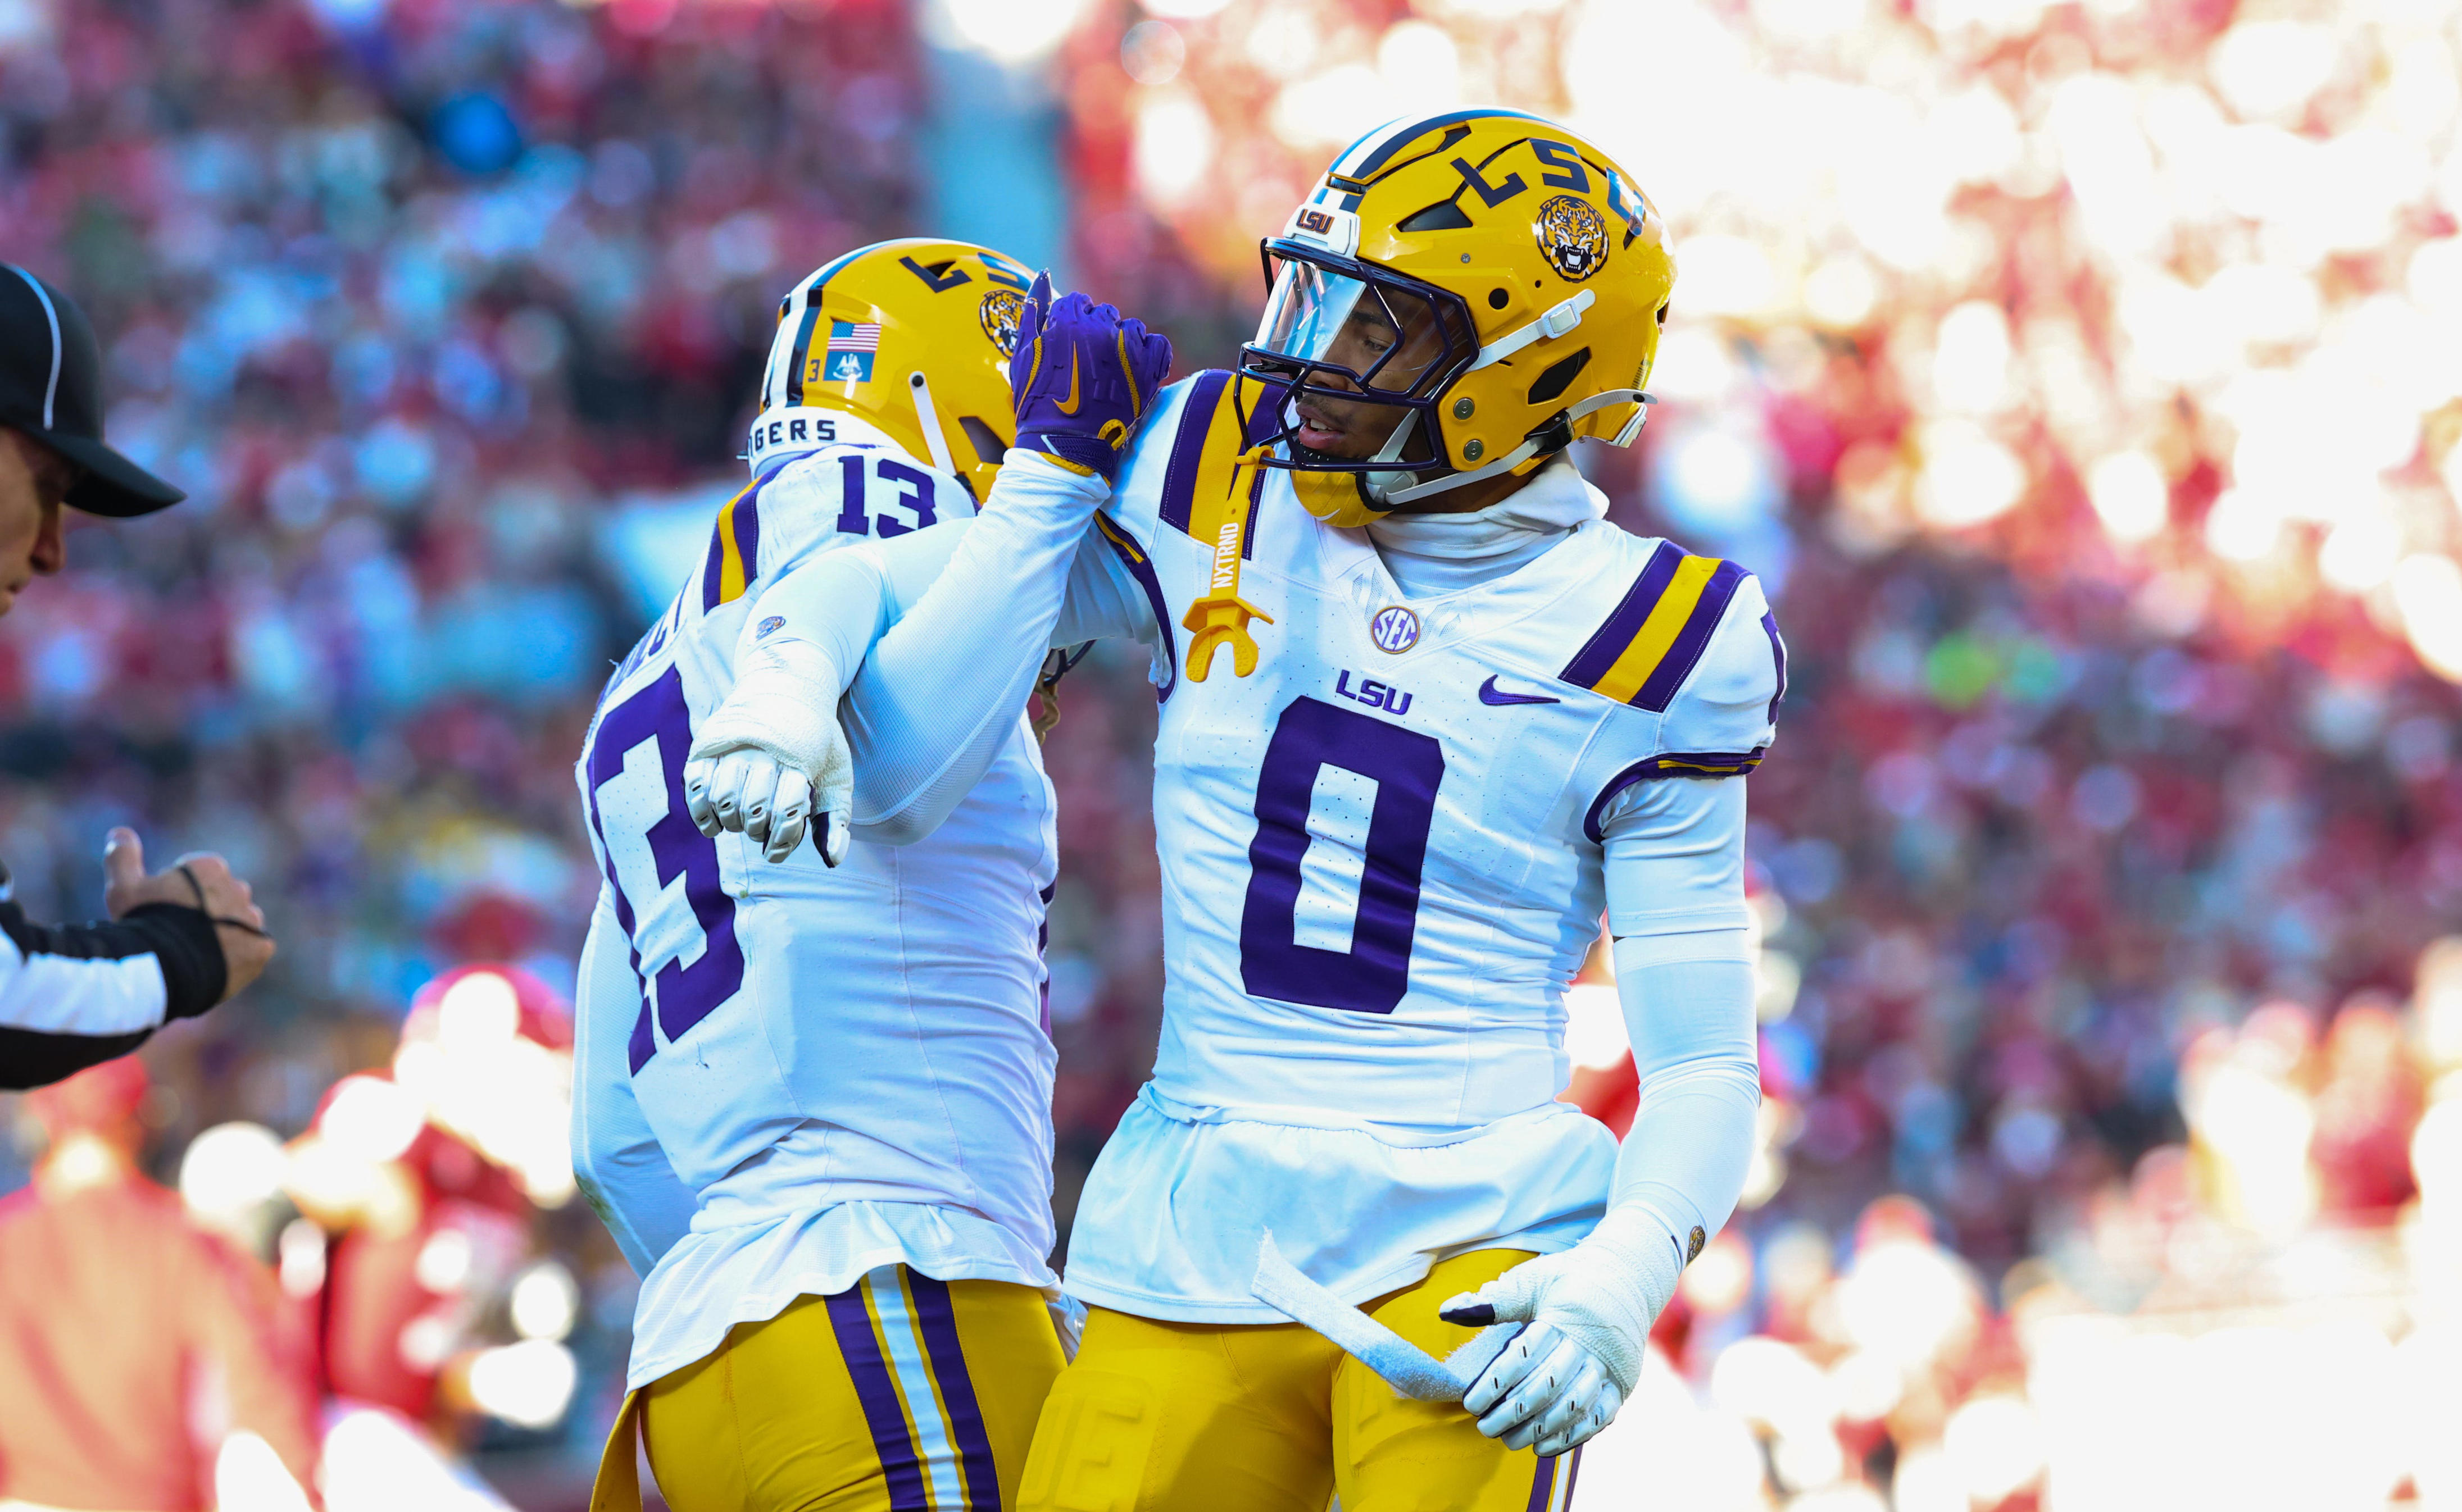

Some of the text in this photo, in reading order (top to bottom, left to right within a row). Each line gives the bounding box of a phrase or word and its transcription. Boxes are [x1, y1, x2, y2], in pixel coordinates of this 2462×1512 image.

[1450, 138, 1644, 236] LSU
[1296, 208, 1335, 235] LSU
[898, 252, 1033, 293] LS
[808, 359, 820, 382] 3
[750, 419, 835, 457] GERS
[837, 456, 937, 539] 13
[1212, 522, 1239, 589] NXTRND
[1374, 608, 1416, 652] SEC
[1336, 669, 1412, 715] LSU
[1239, 695, 1446, 1014] 0
